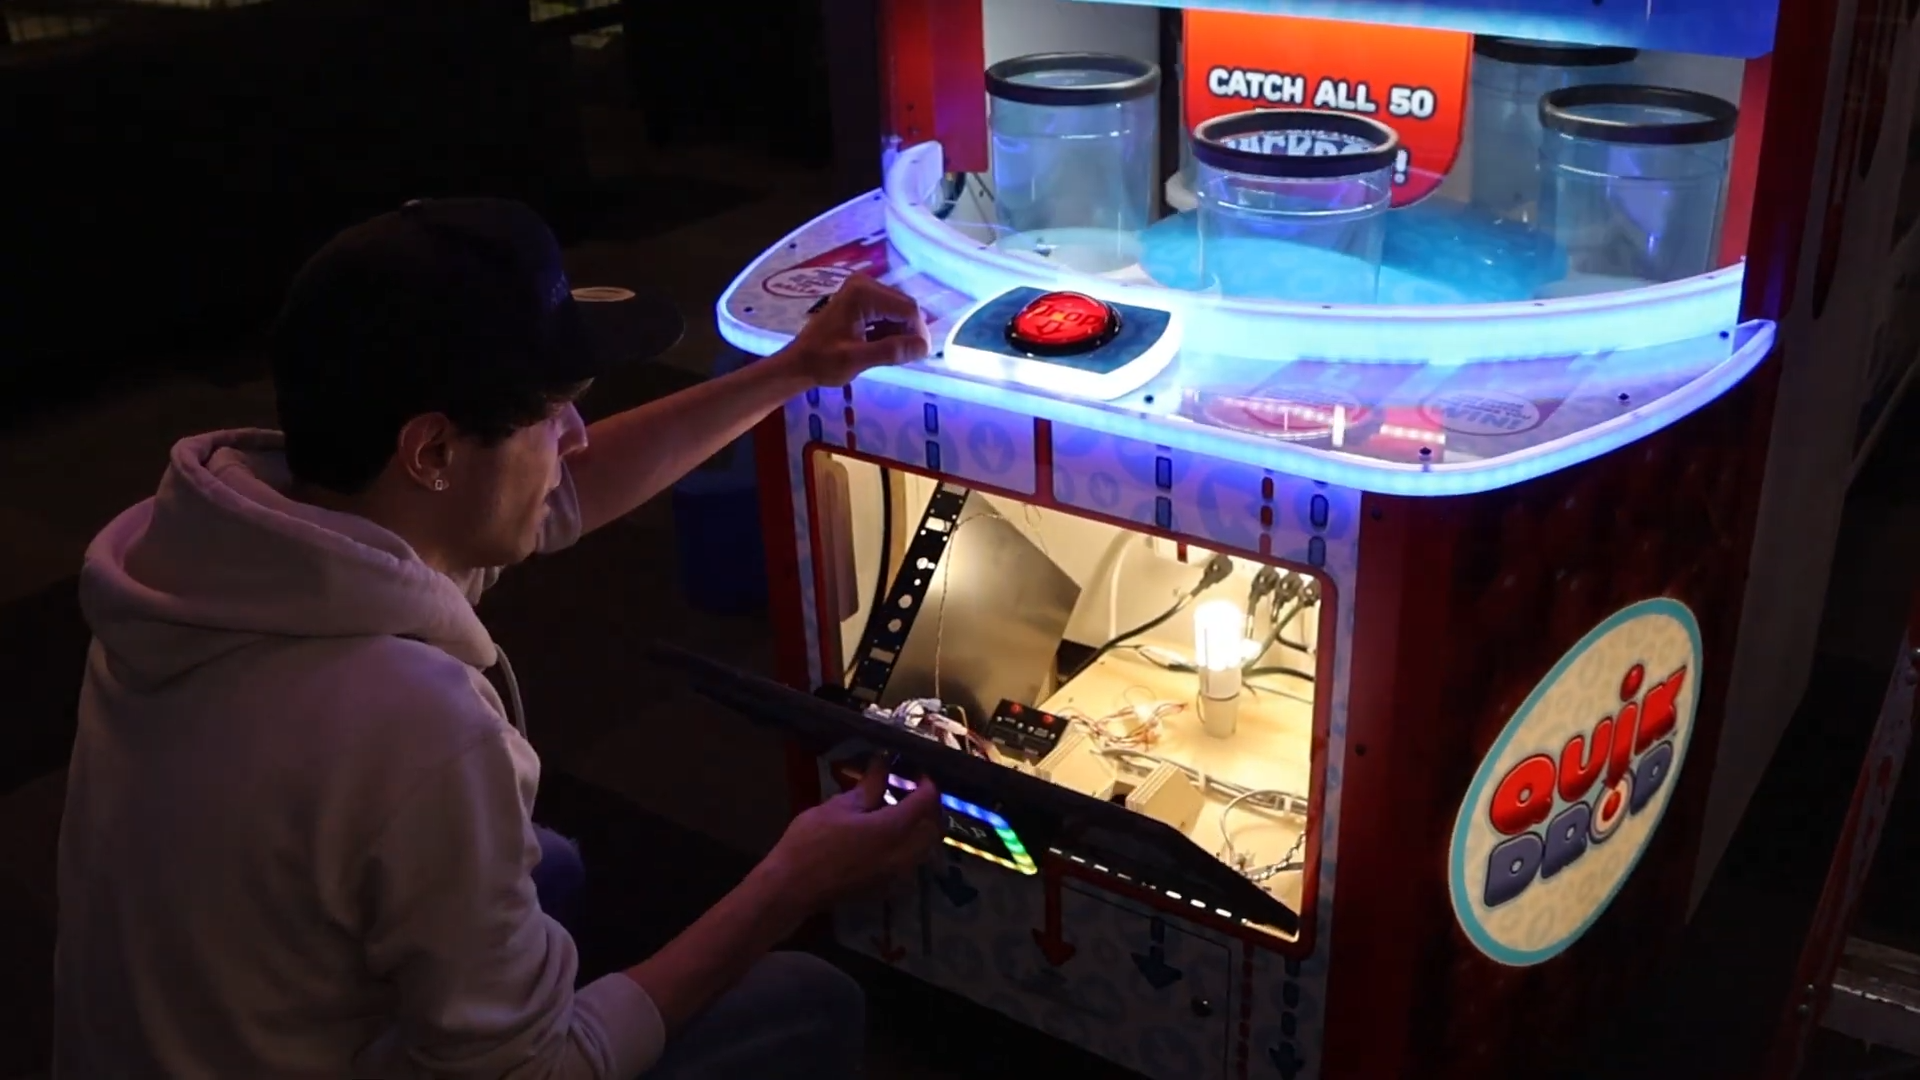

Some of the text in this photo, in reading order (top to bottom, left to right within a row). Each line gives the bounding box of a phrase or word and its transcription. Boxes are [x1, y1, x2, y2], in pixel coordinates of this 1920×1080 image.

[1207, 66, 1436, 118] CATCH ALL 50
[1483, 740, 1675, 908] DROP
